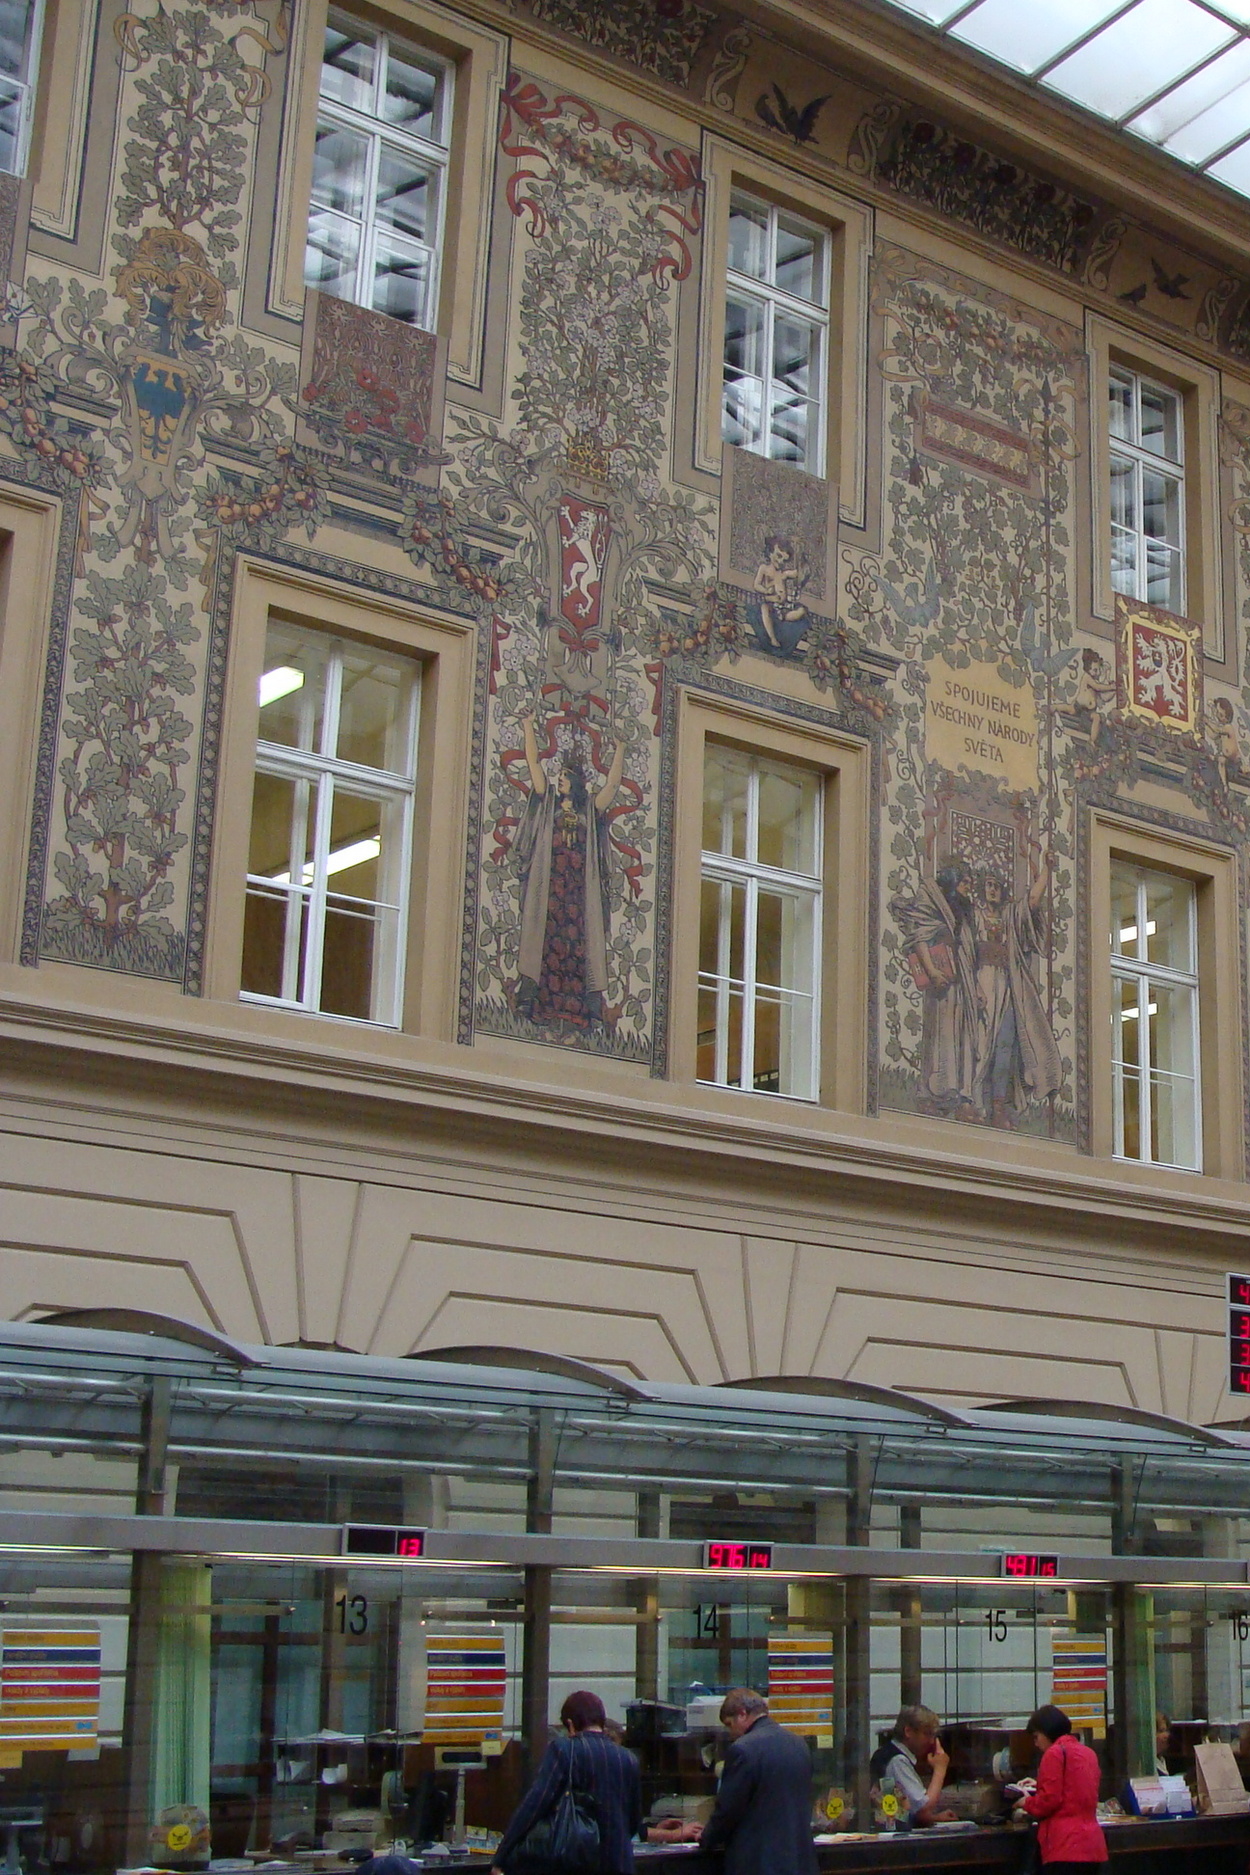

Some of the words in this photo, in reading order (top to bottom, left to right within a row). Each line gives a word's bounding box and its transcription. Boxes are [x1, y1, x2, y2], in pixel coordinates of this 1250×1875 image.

[945, 681, 1020, 719] SPOJUJEME
[930, 700, 984, 731] VŠECHNY
[988, 719, 1035, 748] NÁRODY
[964, 737, 1004, 763] SVĚTA
[399, 1538, 421, 1557] 13
[710, 1544, 746, 1569] 976
[751, 1553, 769, 1568] 14
[1006, 1555, 1037, 1577] 431
[1042, 1563, 1055, 1577] 15
[336, 1595, 368, 1635] 13
[693, 1604, 720, 1639] 14
[985, 1609, 1007, 1642] 15
[1230, 1609, 1248, 1640] 16
